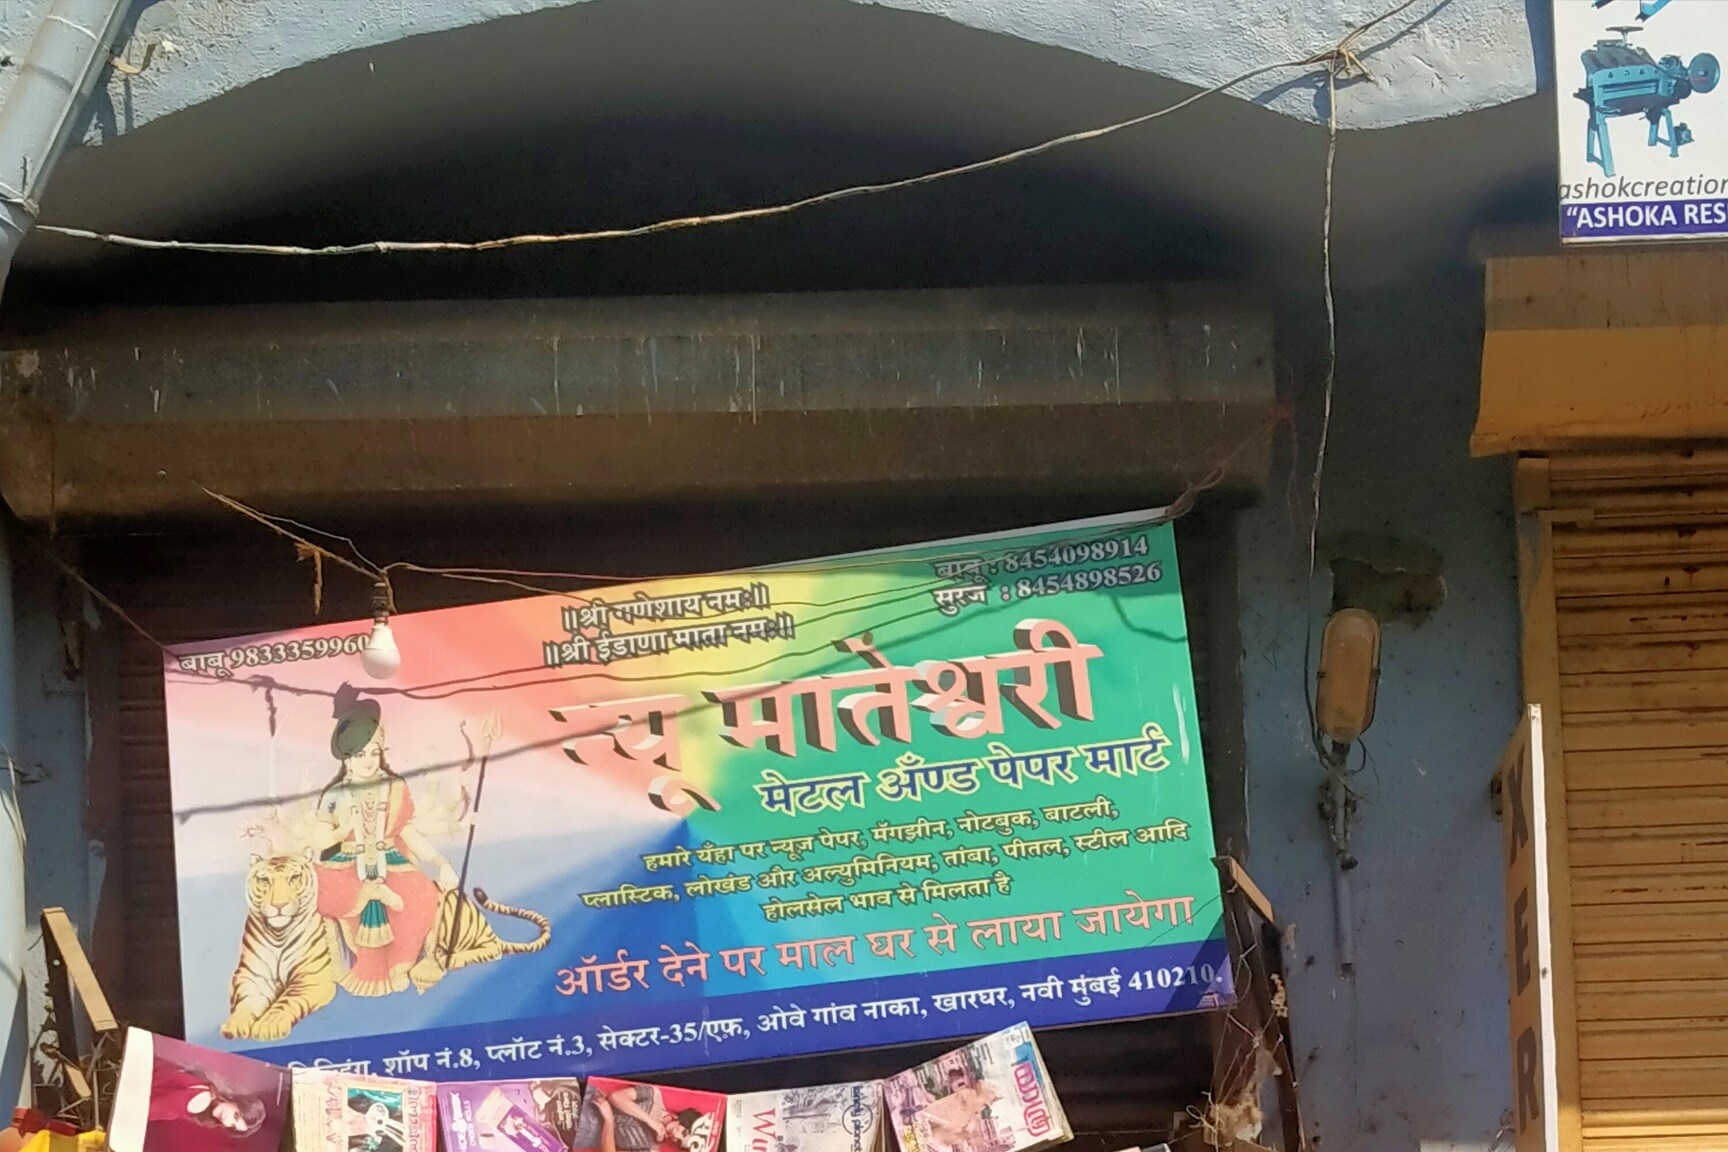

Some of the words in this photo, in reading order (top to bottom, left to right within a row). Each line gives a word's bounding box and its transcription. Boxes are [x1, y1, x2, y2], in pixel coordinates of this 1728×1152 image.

[1003, 535, 1148, 573] 8454098914
[932, 584, 988, 617] सुरज
[1015, 561, 1162, 599] 8454898526
[179, 651, 233, 678] बाबू
[231, 634, 370, 668] 9833359960
[673, 624, 727, 651] माता
[754, 770, 868, 817] मेटल
[990, 740, 1078, 788] पेपर
[1084, 723, 1171, 775] मार्ट
[581, 884, 680, 910] प्लास्टिक,
[685, 874, 751, 898] लोखंड
[758, 868, 796, 889] और
[943, 845, 999, 868] तांबा,
[1003, 836, 1070, 861] पीतल,
[1074, 828, 1131, 852] स्टील
[1134, 818, 1190, 844] आदि
[643, 846, 693, 872] हमारे
[740, 841, 766, 859] पर
[818, 828, 868, 849] पेपर,
[957, 810, 1039, 836] नोटबुक,
[1043, 796, 1119, 822] बाटली,
[762, 894, 844, 922] होलसेल
[849, 889, 893, 911] भाव
[897, 884, 918, 904] से
[922, 876, 992, 902] मिलता
[996, 870, 1014, 895] है
[555, 950, 649, 996] ऑर्डर
[658, 941, 711, 987] देने
[719, 946, 766, 977] पर
[776, 935, 857, 967] माल
[865, 928, 916, 960] घर
[923, 913, 958, 955] से
[968, 911, 1064, 949] लाया
[1072, 890, 1194, 936] जायेगा
[383, 1049, 429, 1077] शॉप
[486, 1037, 541, 1061] प्लॉट
[758, 1003, 806, 1031] ओवे
[813, 1002, 857, 1023] गांव
[863, 994, 927, 1019] नाका,
[933, 987, 1016, 1012] खारघर,
[1019, 978, 1064, 1003] नवी
[1068, 967, 1122, 1006] मुंबई
